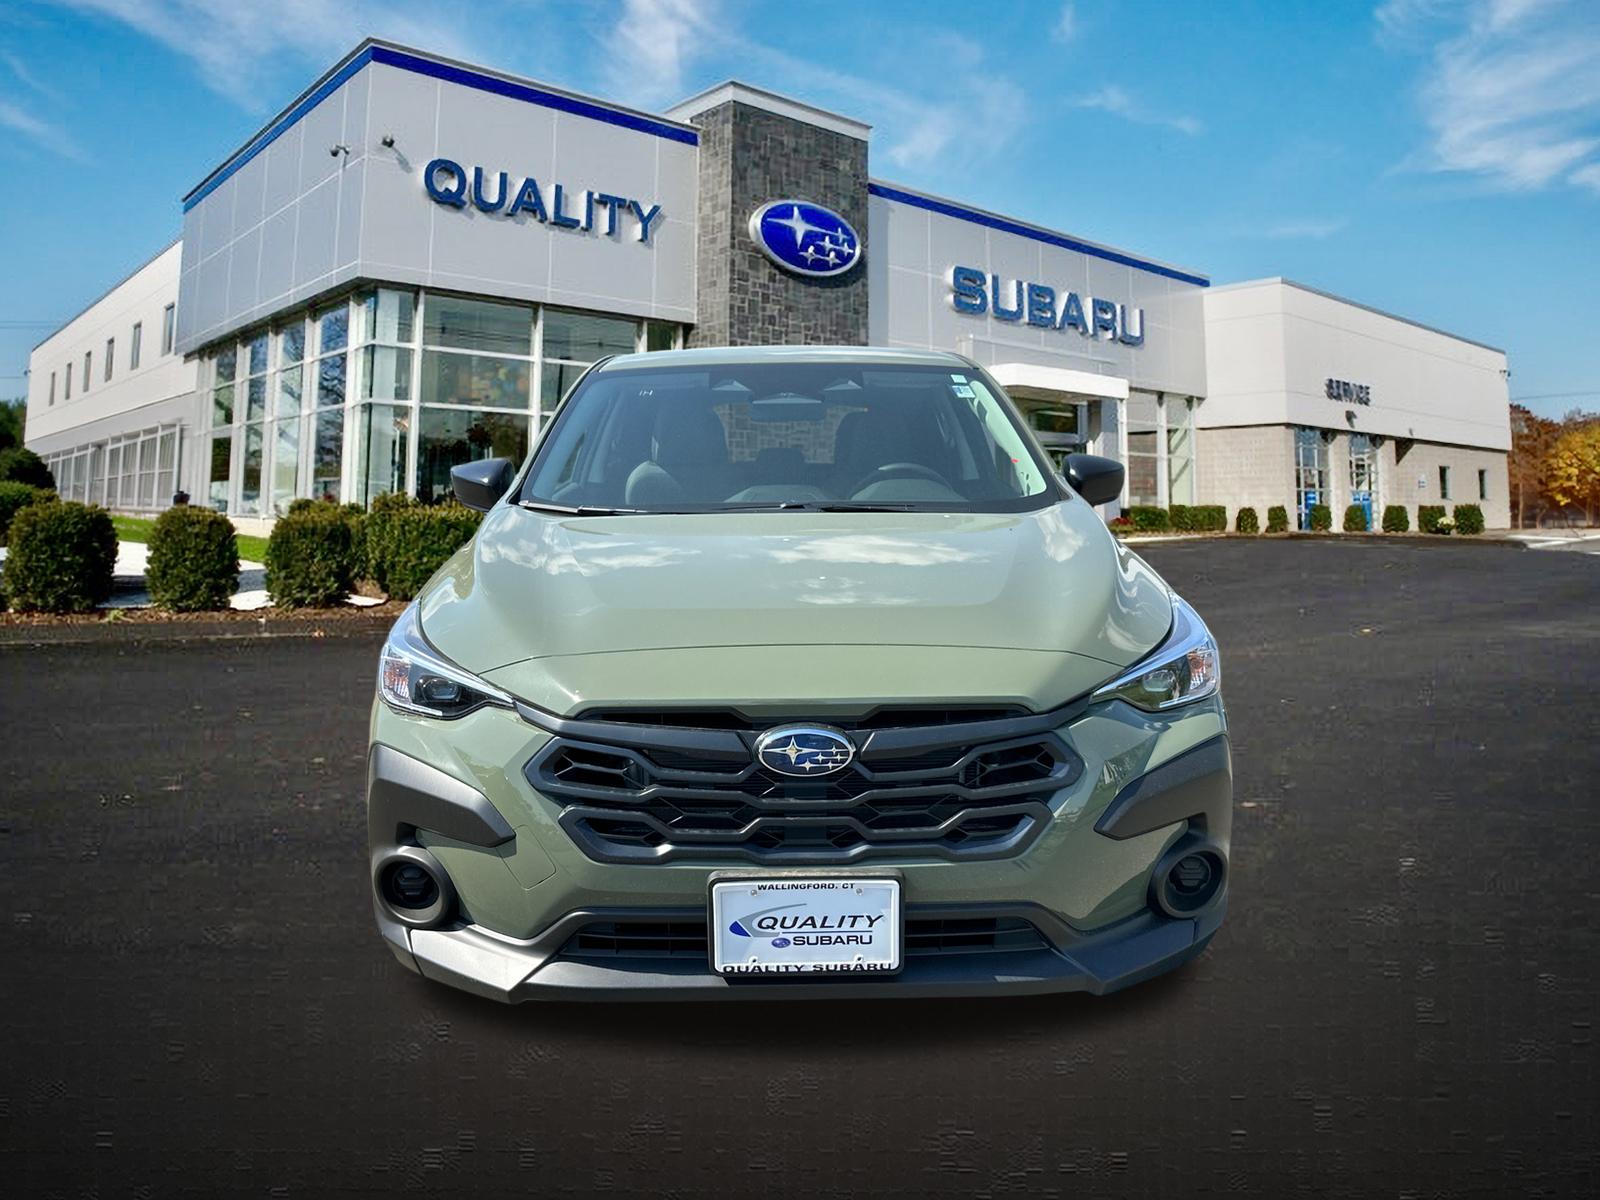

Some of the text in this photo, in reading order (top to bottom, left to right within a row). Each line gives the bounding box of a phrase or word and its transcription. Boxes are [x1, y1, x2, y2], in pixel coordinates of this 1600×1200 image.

[424, 158, 661, 243] QUALITY
[952, 265, 1145, 346] SUBARU
[757, 915, 884, 930] QUALITY
[793, 935, 873, 945] SUBARU
[723, 963, 892, 973] QUALITY SUBARU
